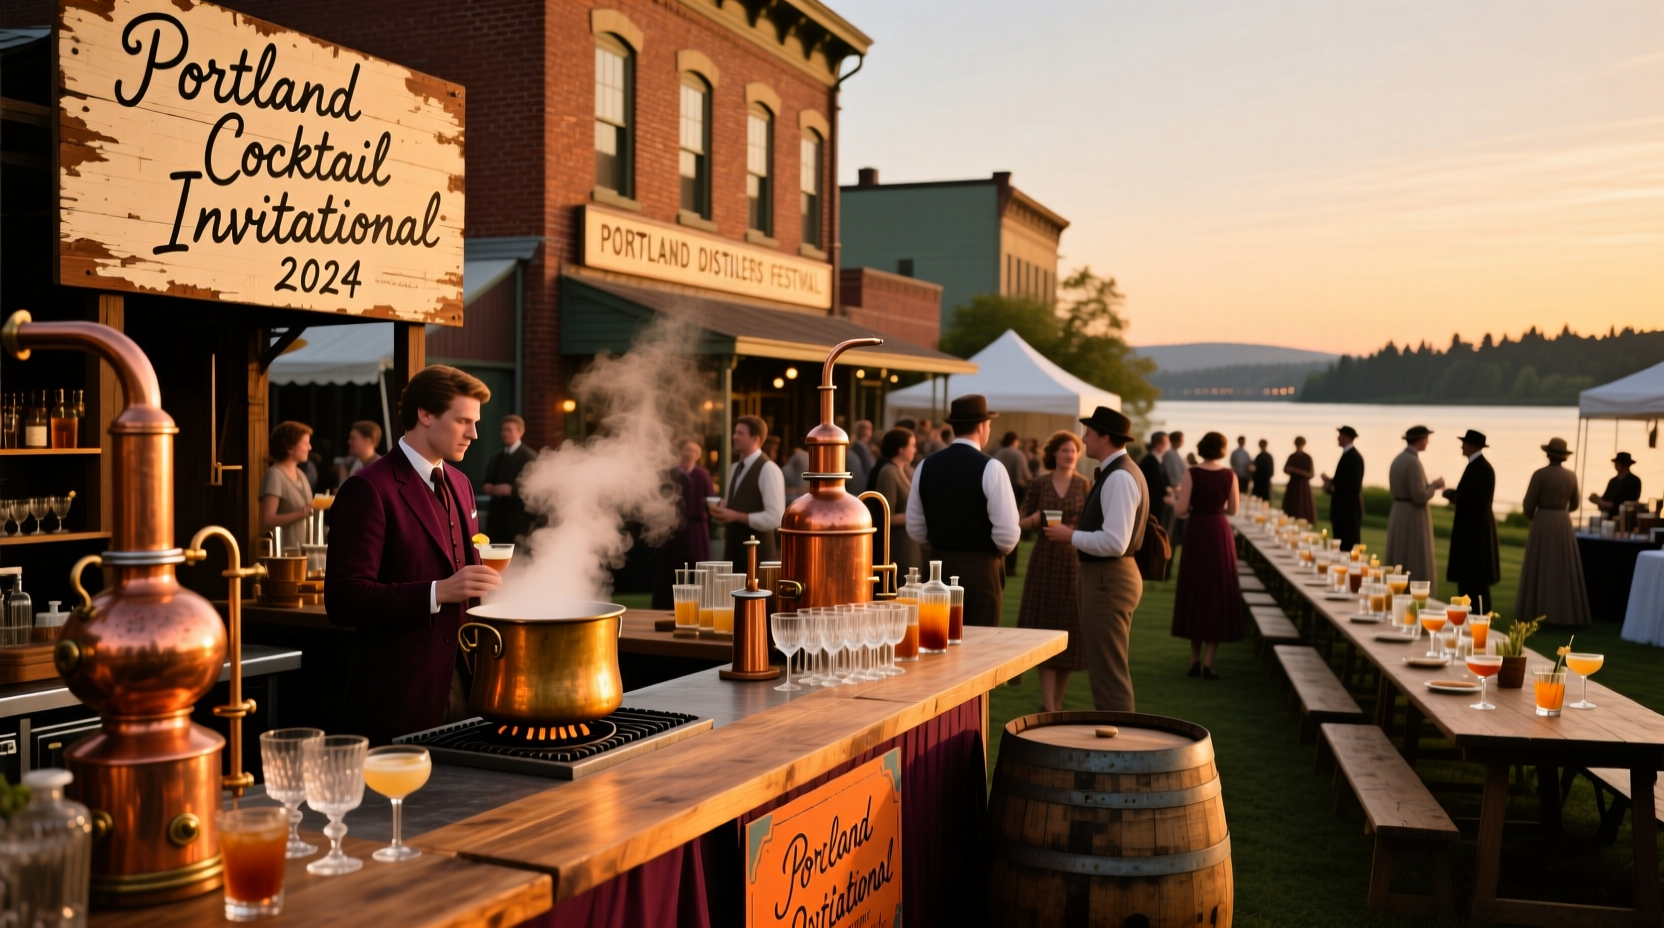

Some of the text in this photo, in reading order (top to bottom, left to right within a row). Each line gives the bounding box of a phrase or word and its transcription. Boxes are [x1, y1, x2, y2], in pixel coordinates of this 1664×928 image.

[114, 12, 362, 122] Portland
[204, 112, 392, 187] Cocktail
[152, 170, 442, 255] Invitational
[600, 223, 691, 269] PORTLAND
[274, 256, 362, 298] 2024
